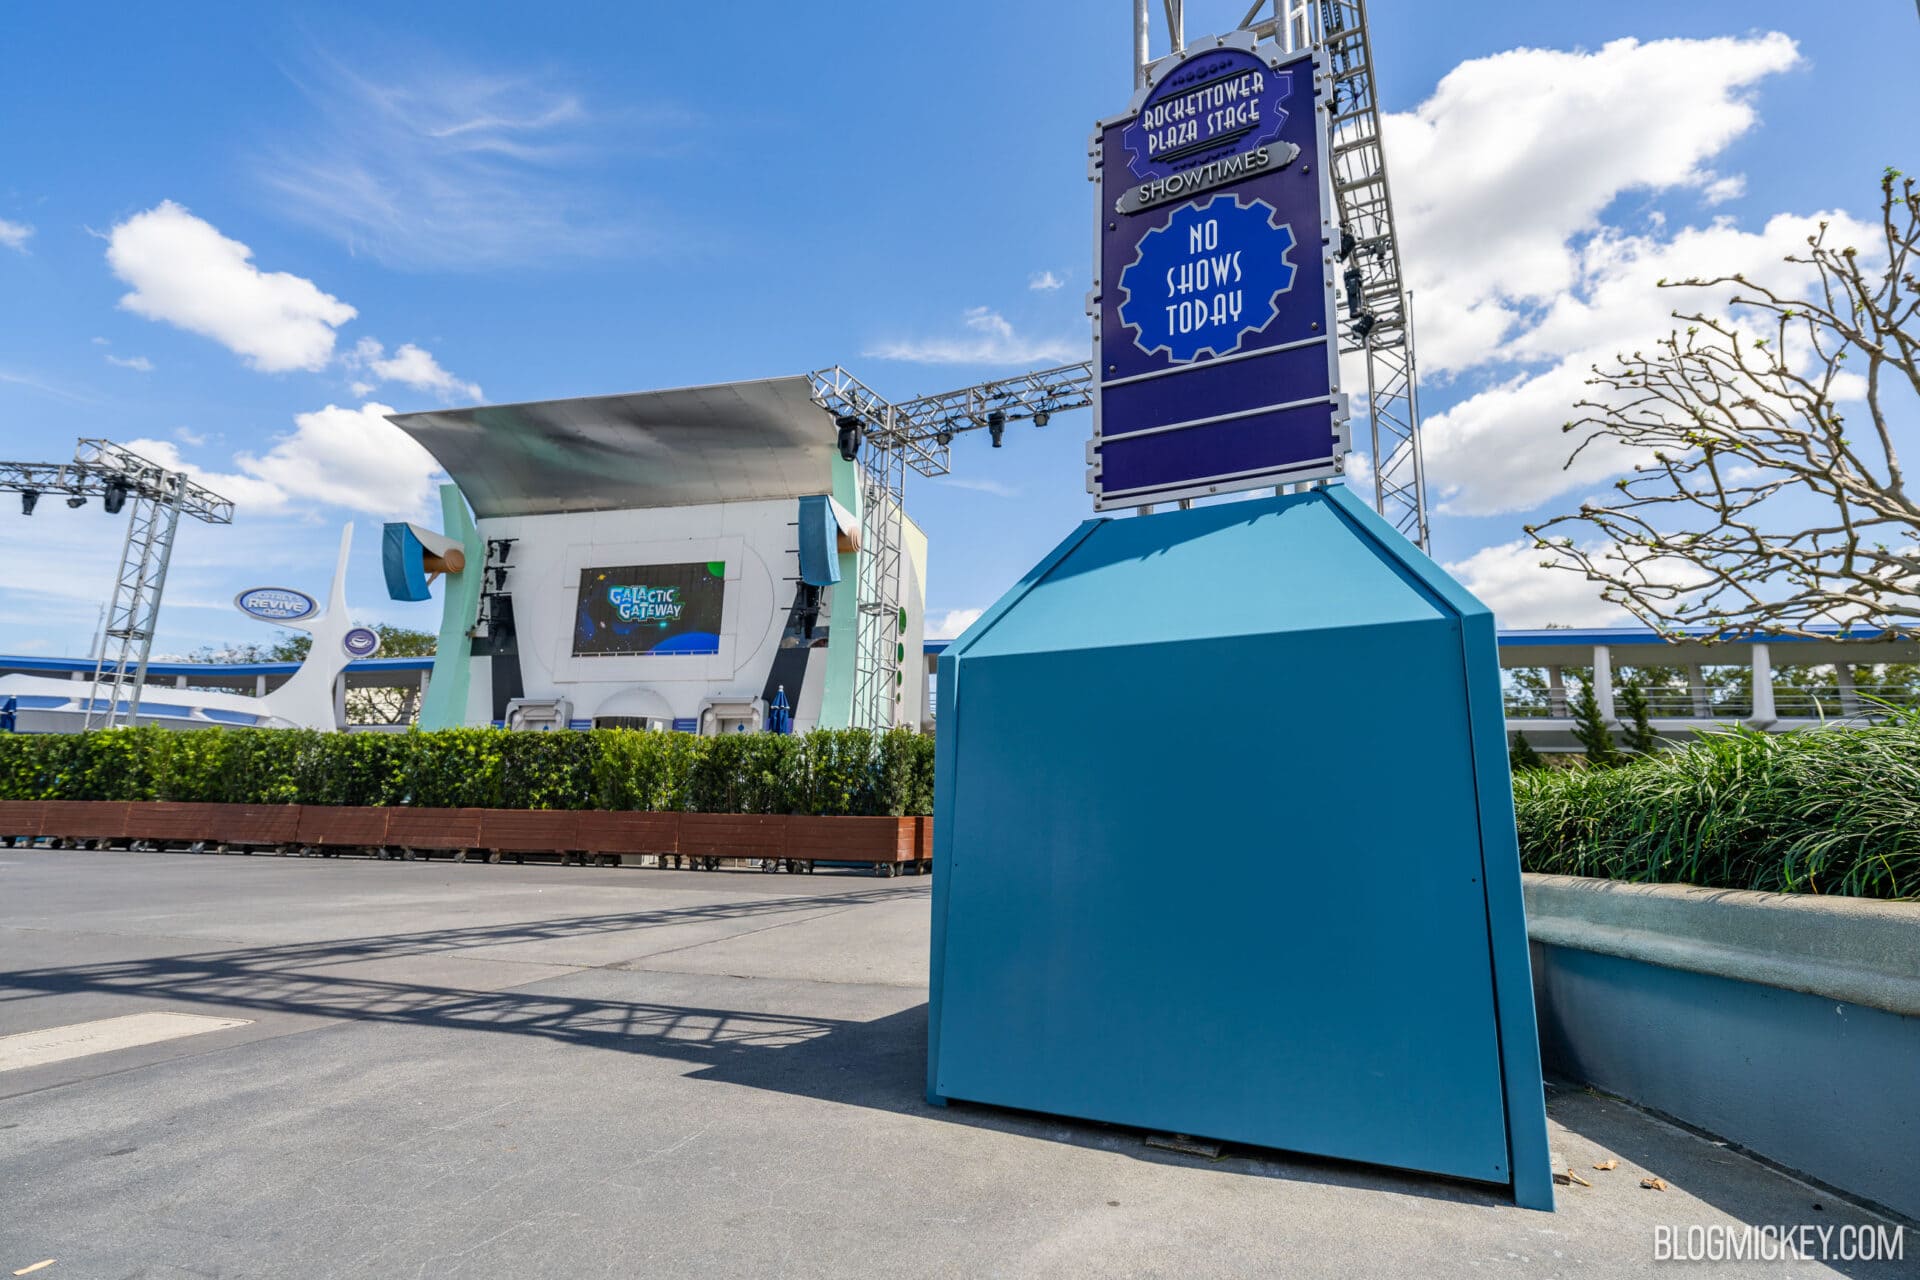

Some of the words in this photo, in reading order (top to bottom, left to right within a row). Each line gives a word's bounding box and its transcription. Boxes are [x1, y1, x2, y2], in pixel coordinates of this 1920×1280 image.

[1142, 72, 1264, 131] ROCKETTOWER
[1148, 122, 1198, 154] PLAZA
[1207, 98, 1260, 135] STAGE
[1139, 147, 1269, 202] SHOWTIMES
[1189, 219, 1218, 254] NO
[1166, 251, 1242, 297] SHOWS
[1166, 290, 1242, 336] TODAY
[248, 598, 303, 612] REVIVE
[610, 586, 674, 604] GALACTIC
[619, 602, 681, 619] GATEWAY
